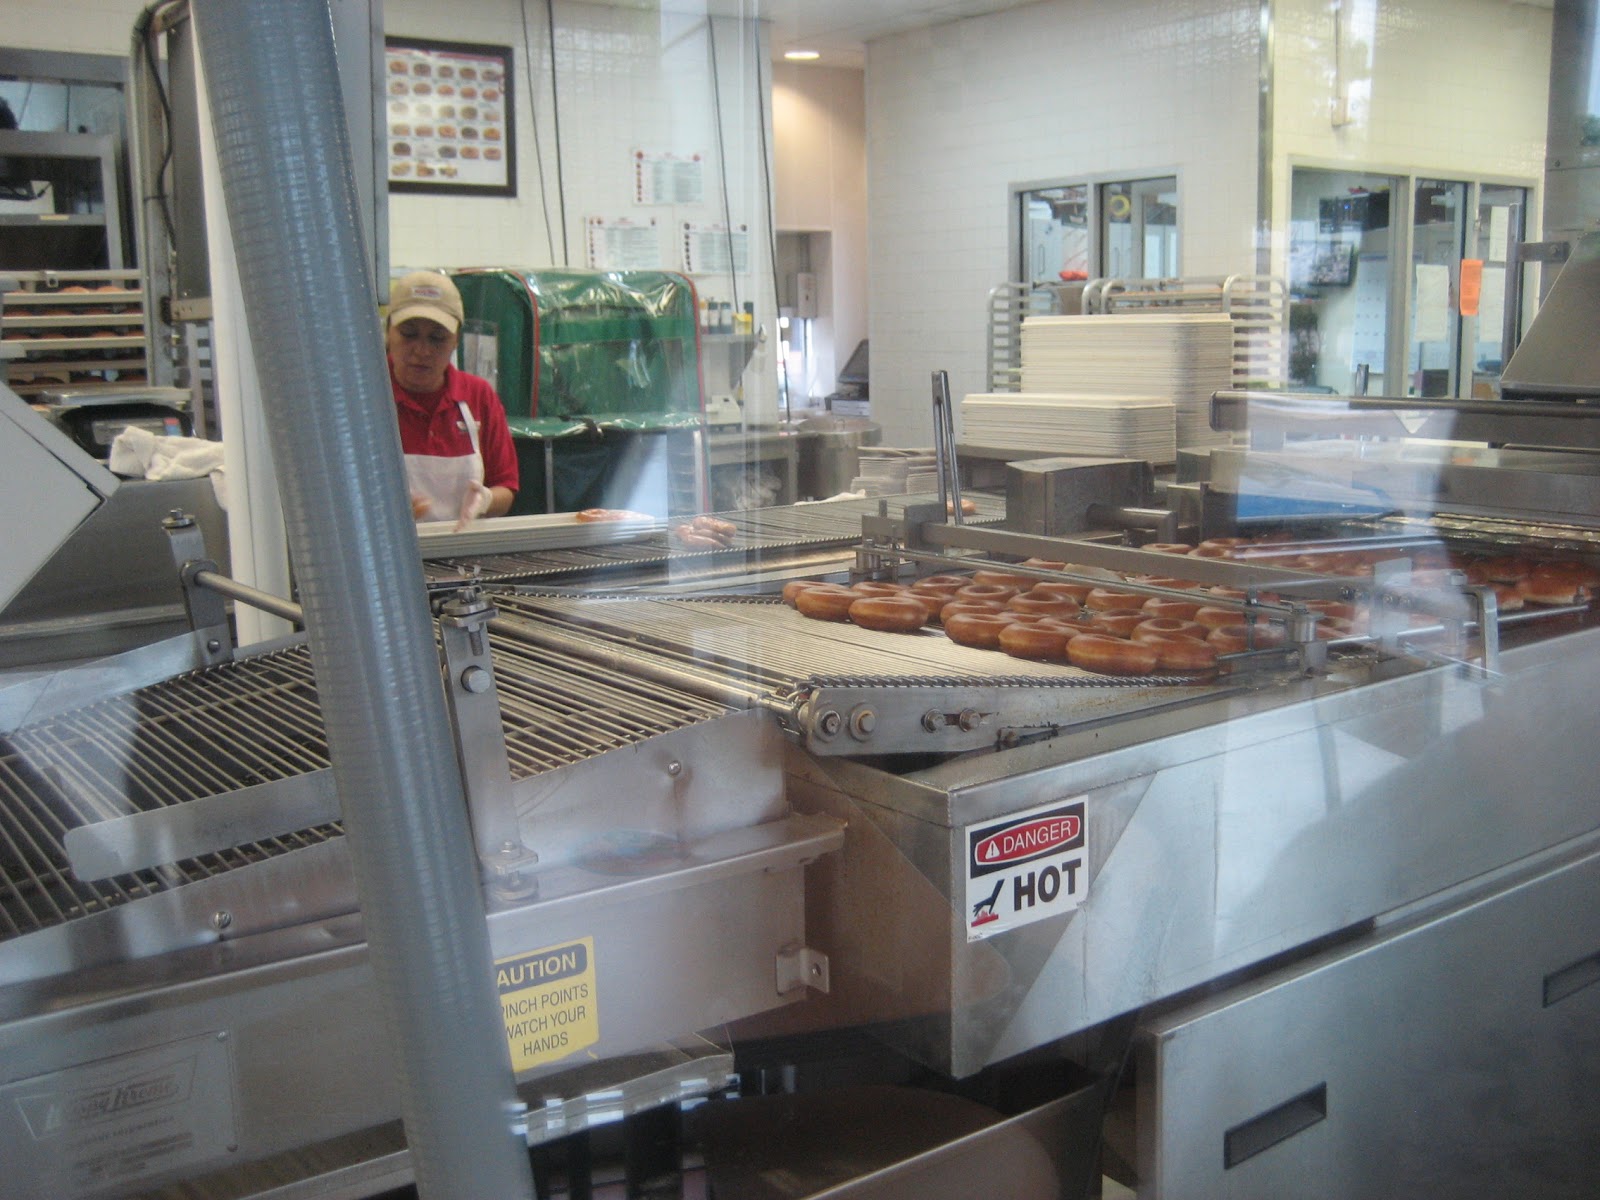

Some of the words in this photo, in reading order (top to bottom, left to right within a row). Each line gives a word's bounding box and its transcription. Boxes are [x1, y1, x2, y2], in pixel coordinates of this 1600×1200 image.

[1003, 820, 1072, 854] DANGER
[1013, 857, 1082, 912] HOT
[496, 951, 577, 988] AUTION
[541, 983, 589, 1009] POINTS
[550, 1005, 586, 1028] YOUR
[523, 1031, 569, 1057] HANDS
